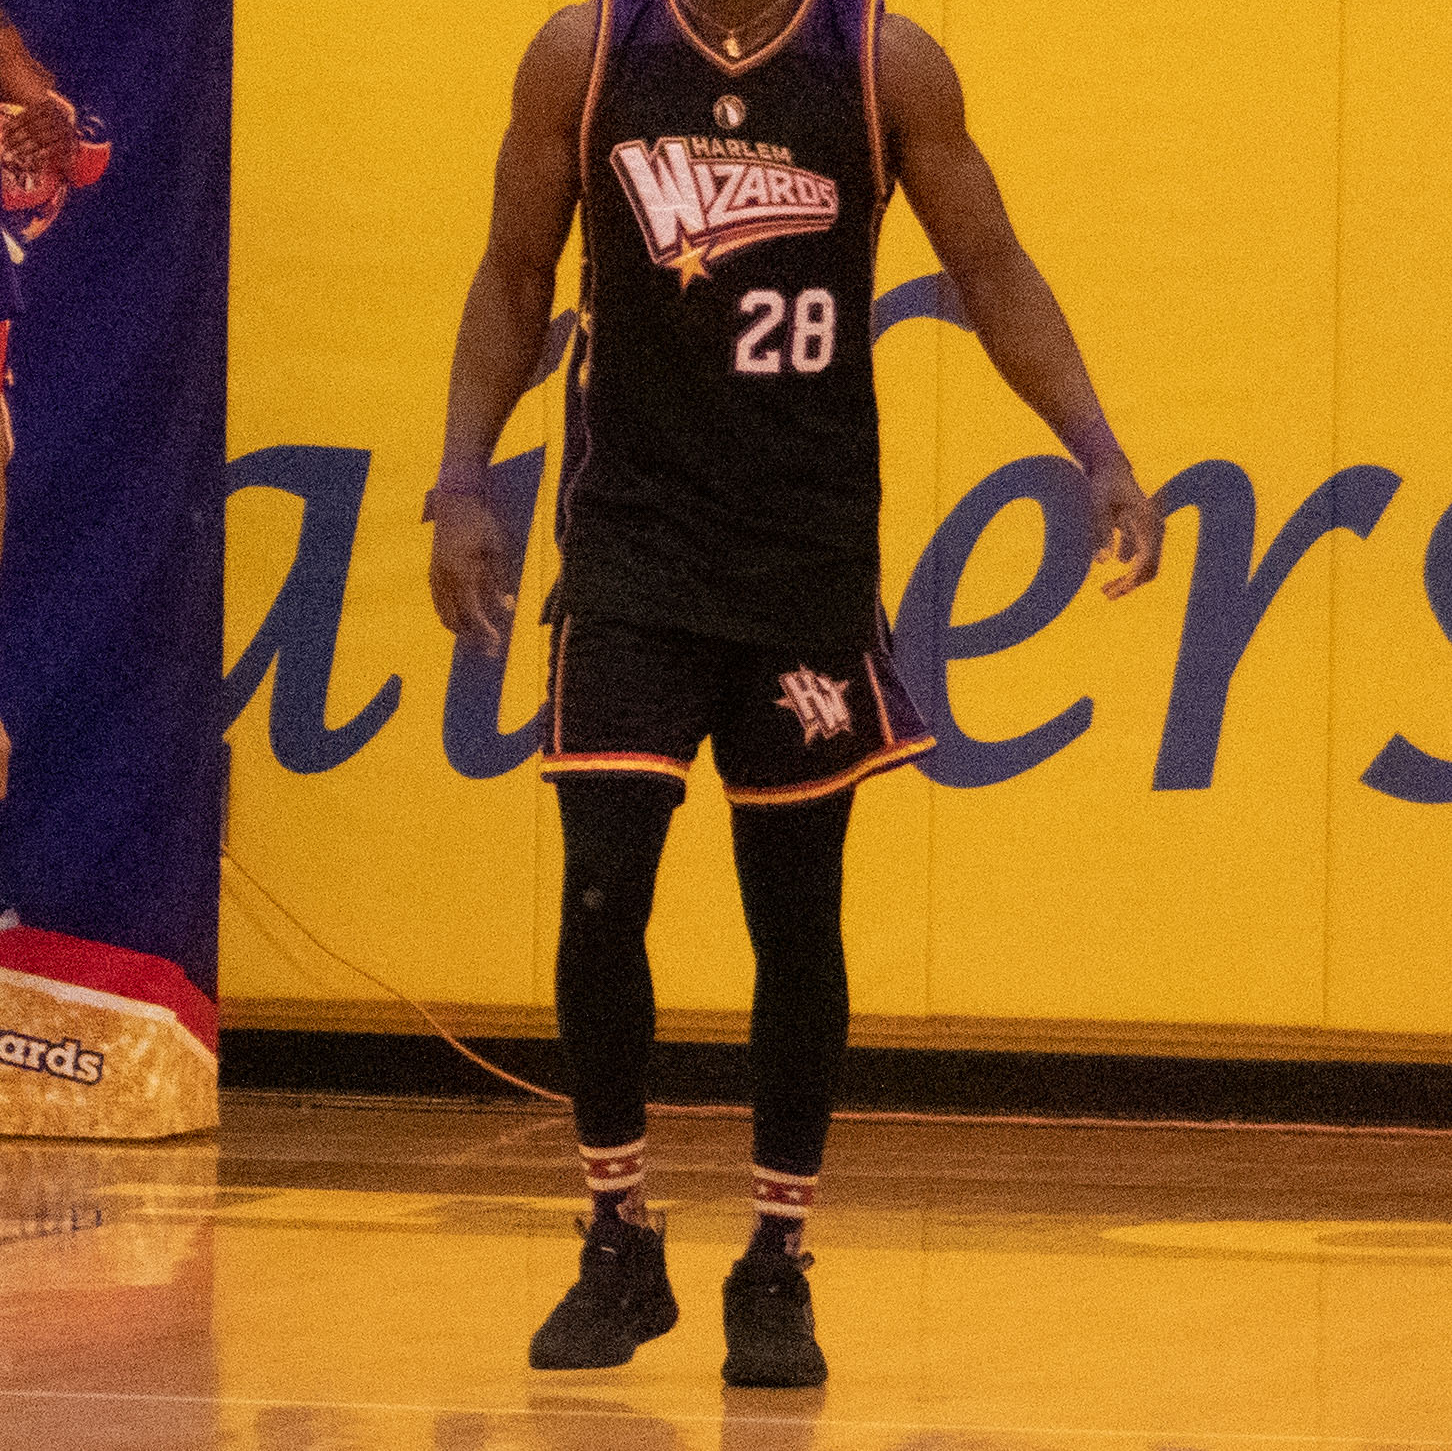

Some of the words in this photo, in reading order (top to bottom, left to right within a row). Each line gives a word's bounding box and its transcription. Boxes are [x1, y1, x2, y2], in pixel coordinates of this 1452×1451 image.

[691, 135, 793, 164] HARLEM
[616, 139, 839, 251] WIZARDS
[734, 287, 836, 374] 28
